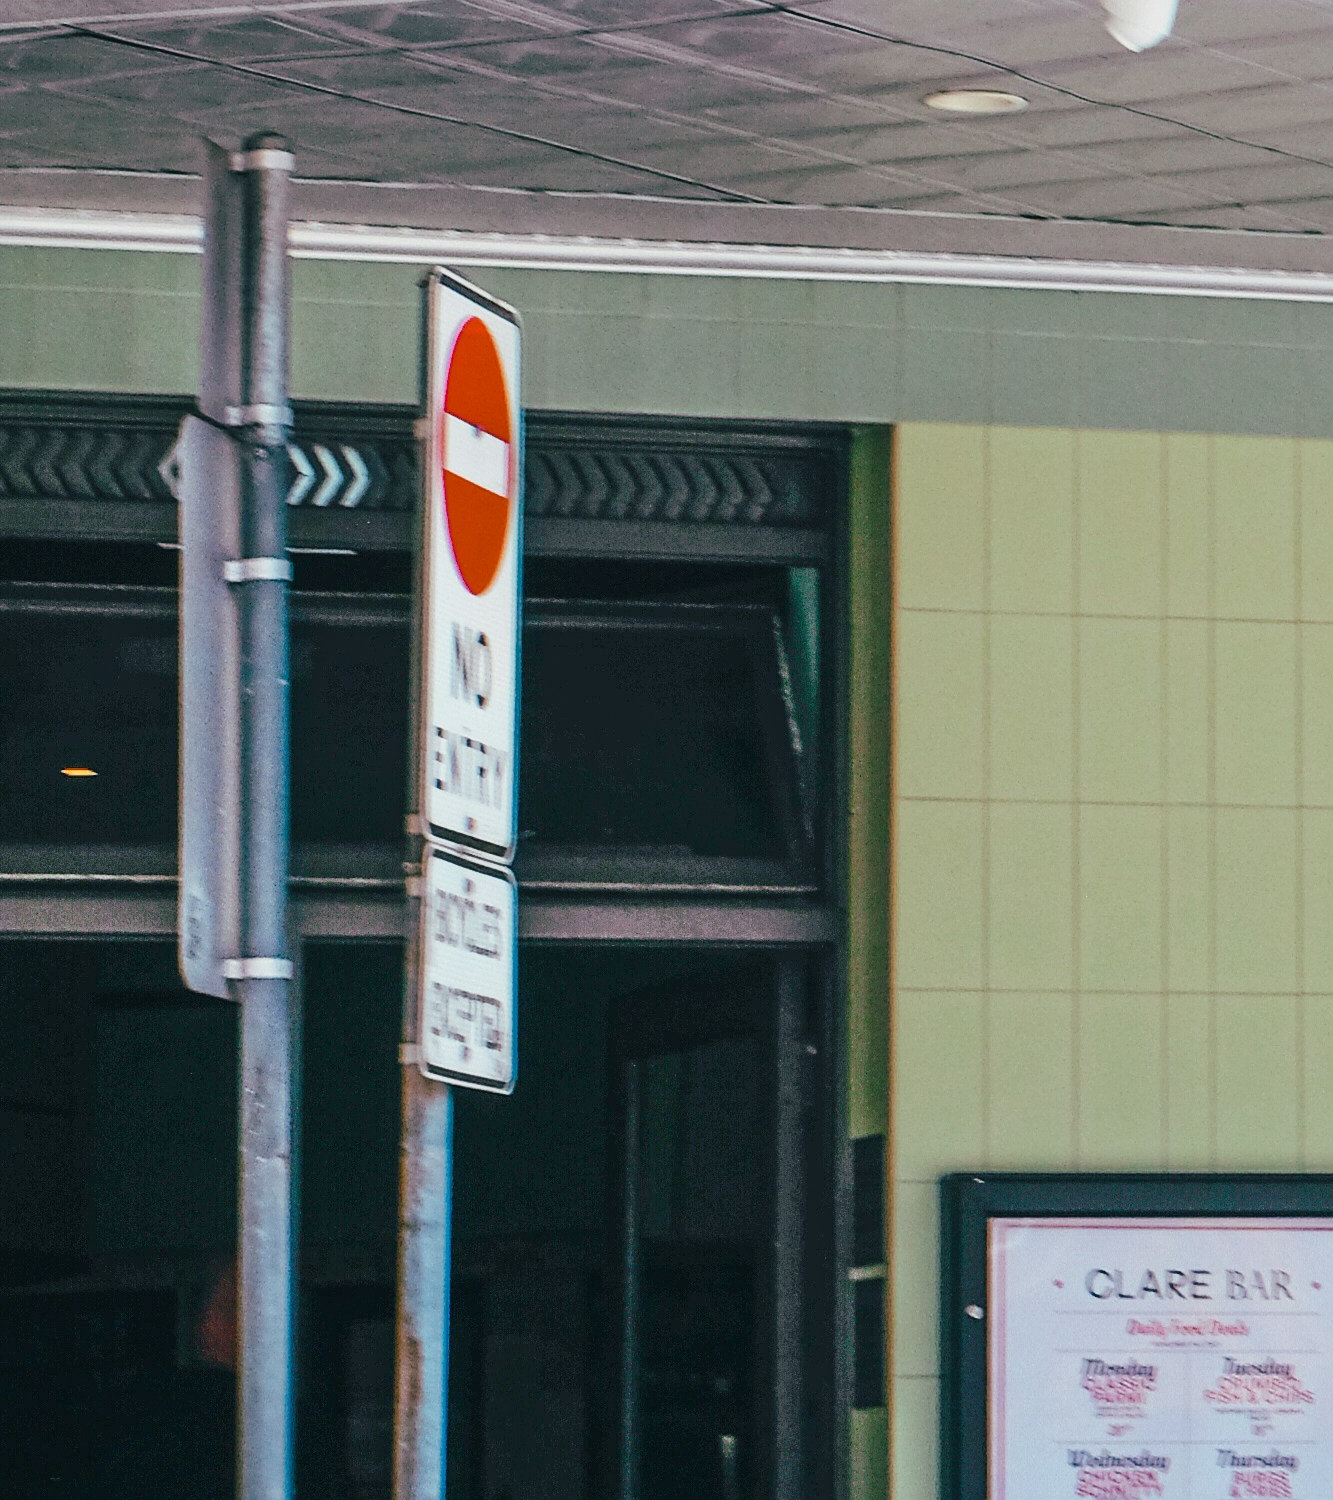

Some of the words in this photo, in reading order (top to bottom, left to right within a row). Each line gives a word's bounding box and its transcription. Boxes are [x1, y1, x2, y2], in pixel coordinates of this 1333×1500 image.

[450, 622, 493, 710] NO
[431, 724, 509, 810] ENTRY
[1085, 1268, 1212, 1300] CLARE
[1225, 1269, 1295, 1301] BAR
[1080, 1357, 1158, 1380] Monday
[1222, 1355, 1295, 1378] Tuesday
[1067, 1448, 1171, 1472] Wednesday
[1216, 1448, 1299, 1472] Thursday
